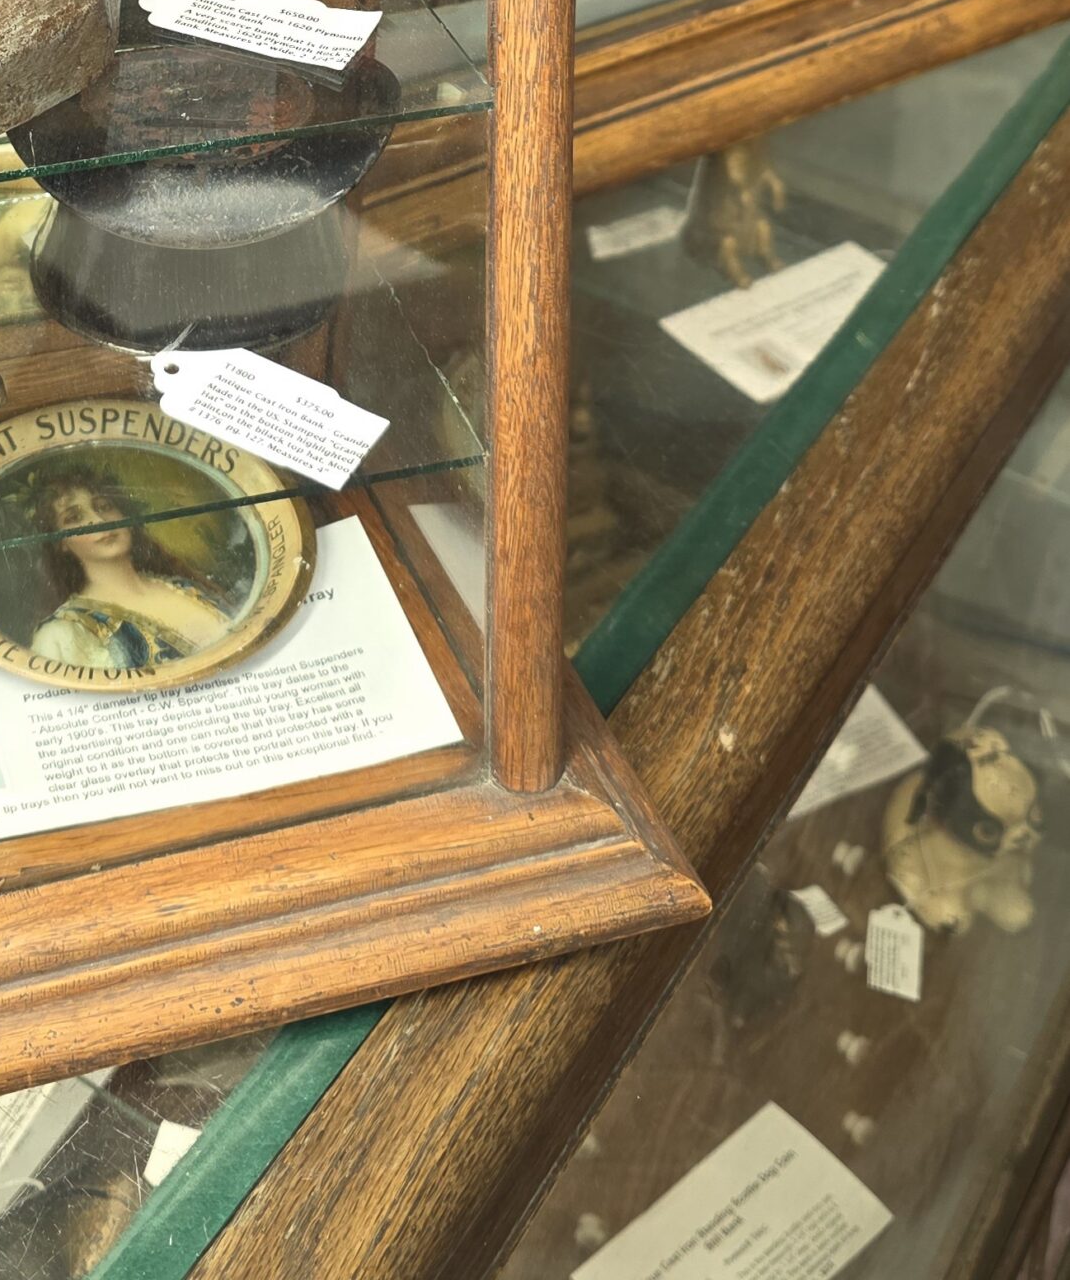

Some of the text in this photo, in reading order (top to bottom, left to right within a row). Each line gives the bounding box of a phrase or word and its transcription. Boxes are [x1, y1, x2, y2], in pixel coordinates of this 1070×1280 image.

[190, 1, 212, 11] Still
[213, 8, 237, 18] Coin
[238, 8, 261, 18] Cast
[214, 374, 254, 395] Antique
[255, 392, 277, 407] Cast
[206, 382, 234, 399] Made
[235, 394, 246, 405] in
[247, 401, 264, 413] the
[282, 418, 328, 443] Stamped
[295, 396, 335, 419] $375.00
[224, 402, 355, 465] on the bottom highlighted
[236, 417, 254, 430] the
[36, 406, 242, 474] SUSPENDERS
[262, 514, 287, 598] SPANGLER
[29, 711, 54, 724] This
[66, 703, 89, 716] 1/4"
[92, 694, 141, 712] diameter
[143, 690, 159, 703] tip
[160, 686, 182, 700] tray
[184, 675, 241, 694] advertises
[298, 645, 365, 670] Suspenders
[35, 734, 64, 748] early
[110, 721, 136, 733] This
[138, 715, 160, 730] tray
[161, 708, 203, 726] depicts
[215, 694, 262, 713] beautiful
[263, 687, 300, 704] young
[301, 677, 342, 694] woman
[342, 669, 367, 684] with
[39, 719, 90, 735] Absolute
[91, 707, 138, 724] Comfort
[59, 686, 347, 756] advertising wordage Excellent
[275, 715, 330, 738] protected
[41, 744, 140, 771] original condition
[253, 738, 294, 755] portrait
[286, 738, 351, 759] exceptional
